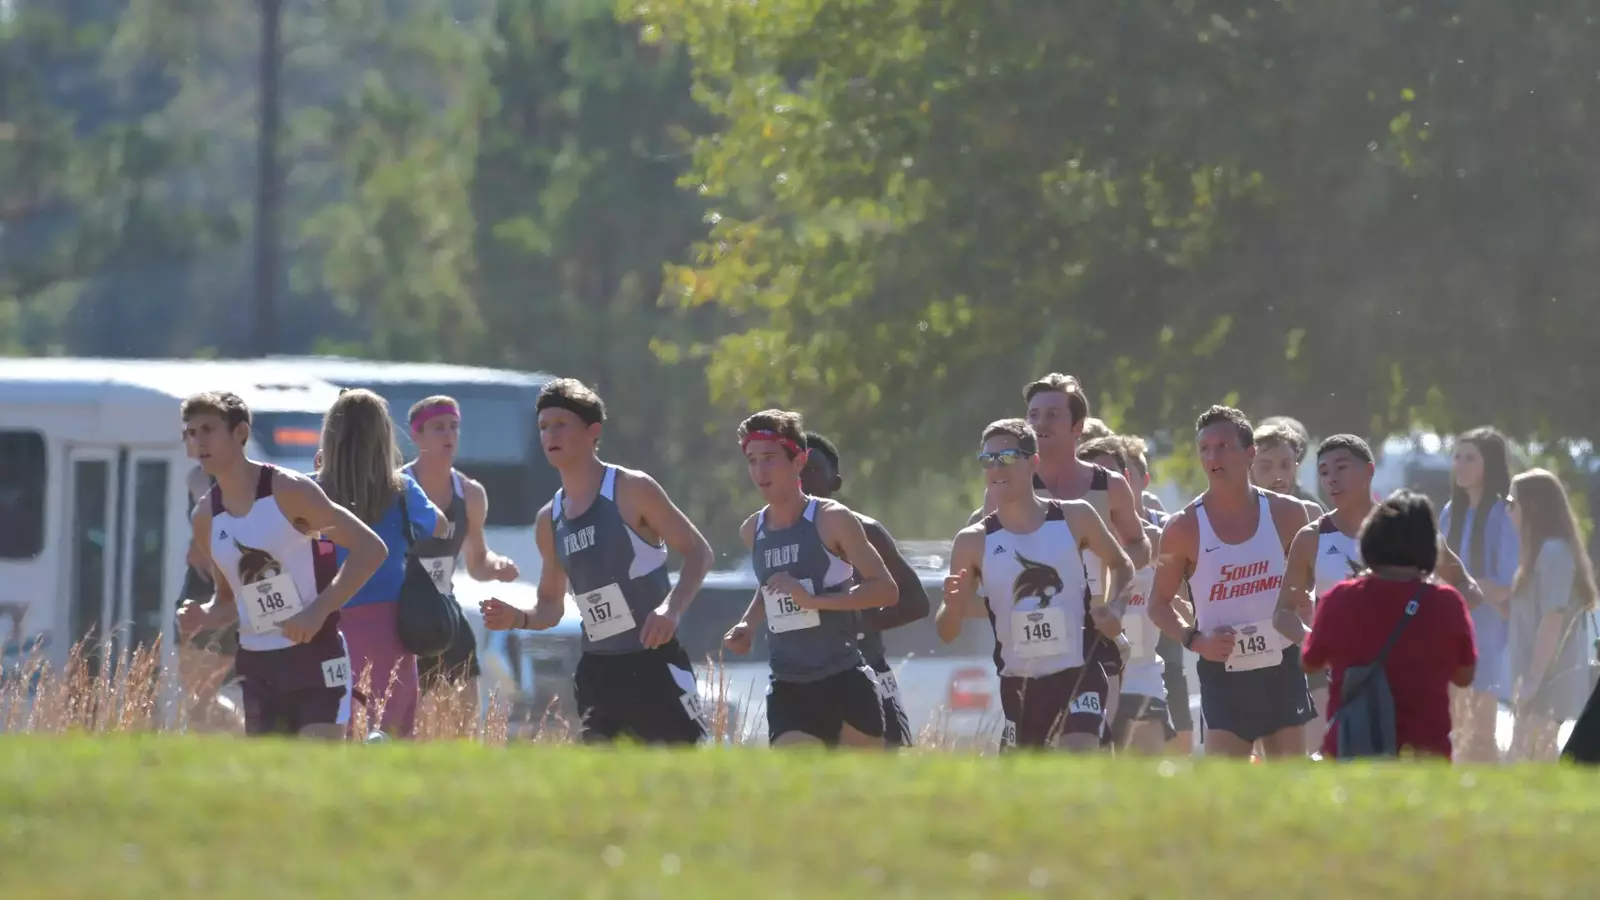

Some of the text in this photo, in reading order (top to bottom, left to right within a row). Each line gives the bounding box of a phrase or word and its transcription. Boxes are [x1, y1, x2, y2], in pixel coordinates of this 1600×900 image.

[564, 525, 595, 555] TROY
[765, 544, 800, 568] TROY
[257, 592, 285, 612] 148
[588, 602, 611, 622] 157
[1023, 622, 1051, 640] 146
[1237, 635, 1266, 654] 143
[1072, 695, 1099, 711] 146
